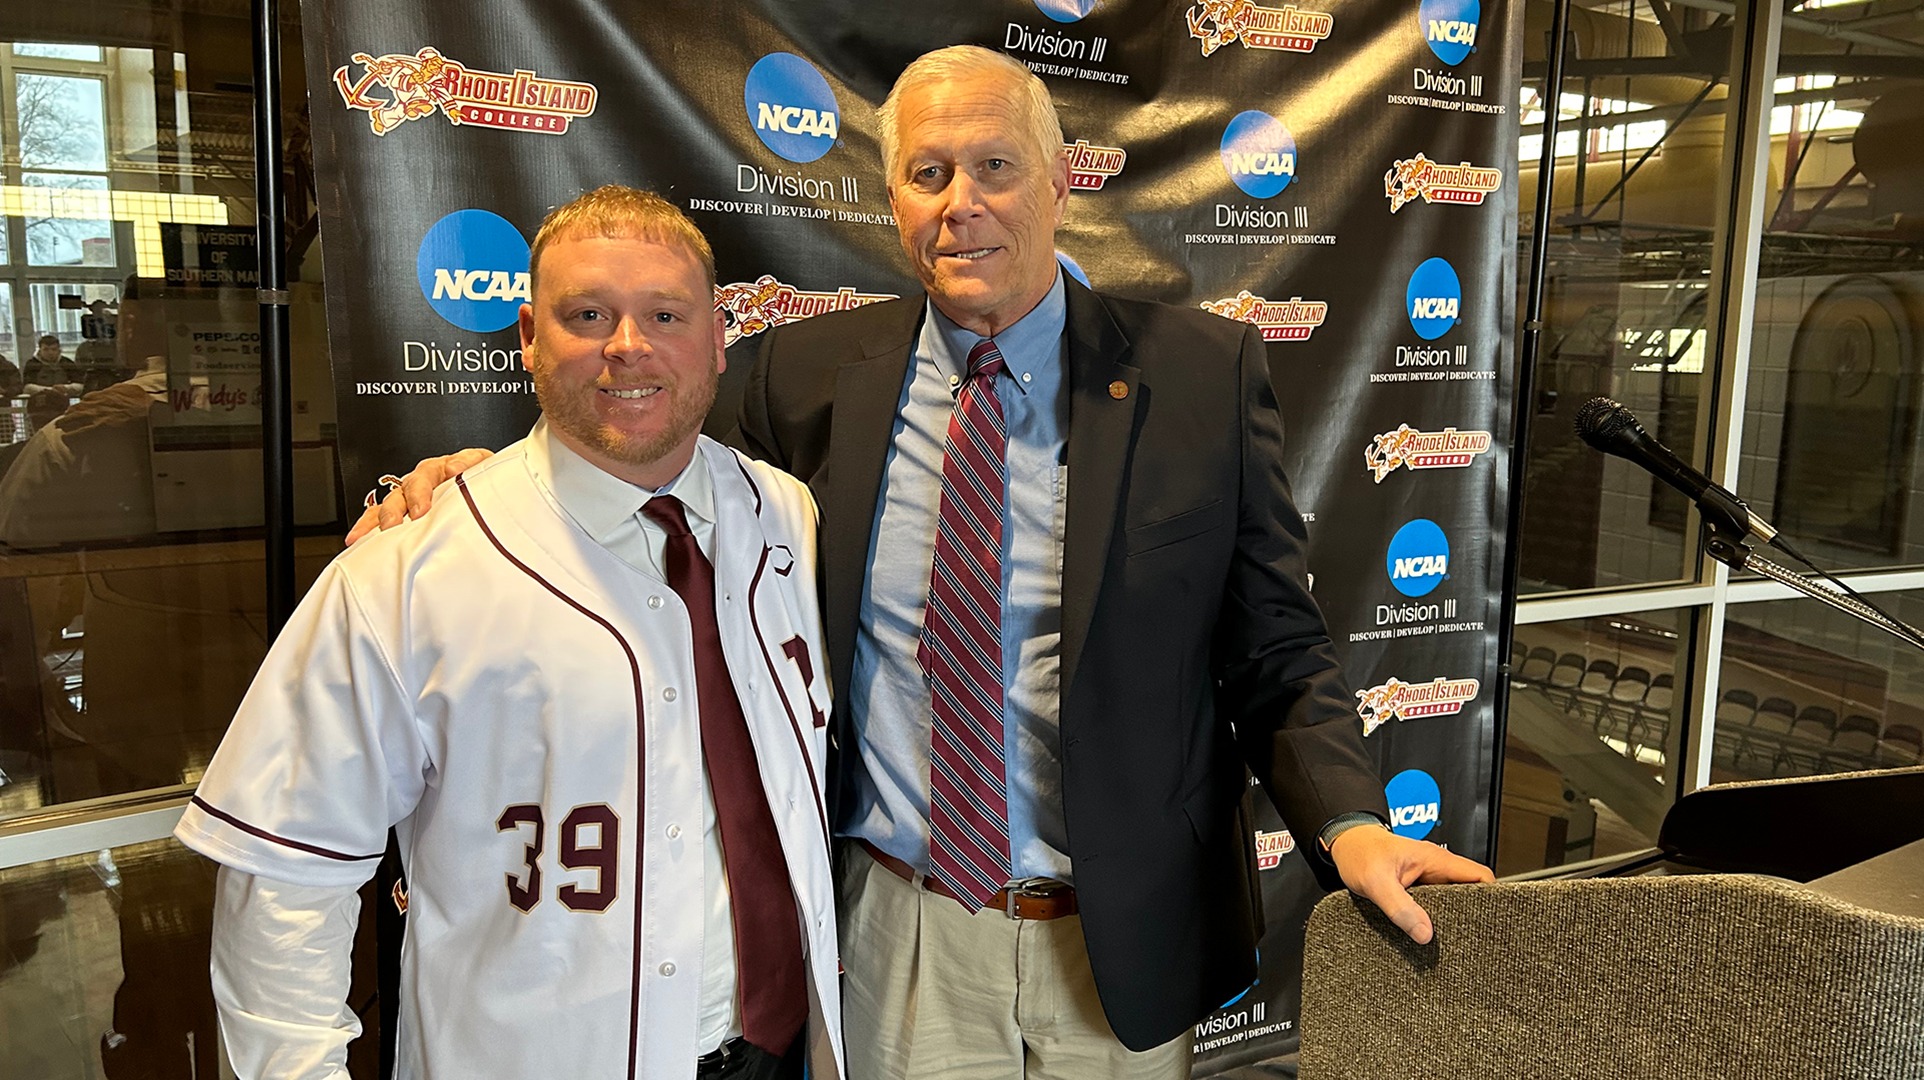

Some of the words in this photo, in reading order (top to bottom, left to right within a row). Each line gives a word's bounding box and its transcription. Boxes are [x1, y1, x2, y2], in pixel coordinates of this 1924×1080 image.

[1244, 5, 1281, 29] RHODE
[1284, 10, 1329, 34] ISLAND
[1004, 22, 1086, 60] Division
[1255, 35, 1309, 49] COLLEGE
[1428, 19, 1477, 47] NCAA
[1027, 60, 1075, 78] DEVELOP
[1079, 68, 1130, 85] DEDICATE
[1413, 67, 1466, 96] Division
[445, 67, 510, 103] RHODE
[516, 76, 592, 111] ISLAND
[1387, 94, 1429, 107] DISCOVER
[1465, 102, 1506, 115] DEDICATE
[470, 109, 557, 129] COLLEGE
[757, 102, 838, 140] NCAA
[1073, 144, 1122, 170] ISLAND
[1231, 152, 1295, 177] NCAA
[736, 163, 835, 201] Division
[1424, 165, 1458, 185] RHODE
[1460, 166, 1497, 187] ISLAND
[1436, 191, 1478, 201] COLLEGE
[689, 198, 763, 216] DISCOVER
[772, 204, 831, 220] DEVELOP
[838, 210, 896, 226] DEDICATE
[1215, 204, 1289, 229] Division
[1185, 234, 1236, 244] DISCOVER
[1240, 234, 1285, 244] DEVELOP
[1291, 235, 1336, 245] DEDICATE
[210, 251, 229, 264] OF
[167, 268, 234, 283] SOUTHERN
[432, 268, 532, 302] NCAA
[778, 288, 835, 317] RHODE
[1254, 302, 1287, 322] RHODE
[1287, 302, 1324, 322] ISLAND
[1411, 297, 1459, 319] NCAA
[1262, 328, 1307, 338] COLLEGE
[403, 340, 528, 372] Division
[1395, 346, 1450, 367] Division
[356, 382, 437, 395] DISCOVER
[447, 381, 522, 394] DEVELOP
[1370, 373, 1408, 383] DISCOVER
[1410, 372, 1445, 381] DEVELOP
[1449, 371, 1496, 380] DEDICATE
[1407, 434, 1441, 451] RHODE
[1444, 432, 1487, 450] ISLAND
[1418, 455, 1466, 465] COLLEGE
[1393, 555, 1447, 579] NCAA
[1376, 602, 1439, 626] Division
[1349, 630, 1392, 642] DISCOVER
[1396, 626, 1434, 638] DEVELOP
[1439, 622, 1484, 633] DEDICATE
[1397, 686, 1432, 703] RHODE
[1434, 682, 1475, 699] ISLAND
[1408, 703, 1456, 716] COLLEGE
[1256, 835, 1292, 853] SLAND
[495, 802, 622, 915] 39
[1195, 1010, 1248, 1038] ivision
[1204, 1033, 1244, 1051] DEVELOP
[1248, 1020, 1293, 1039] DEDICATE
